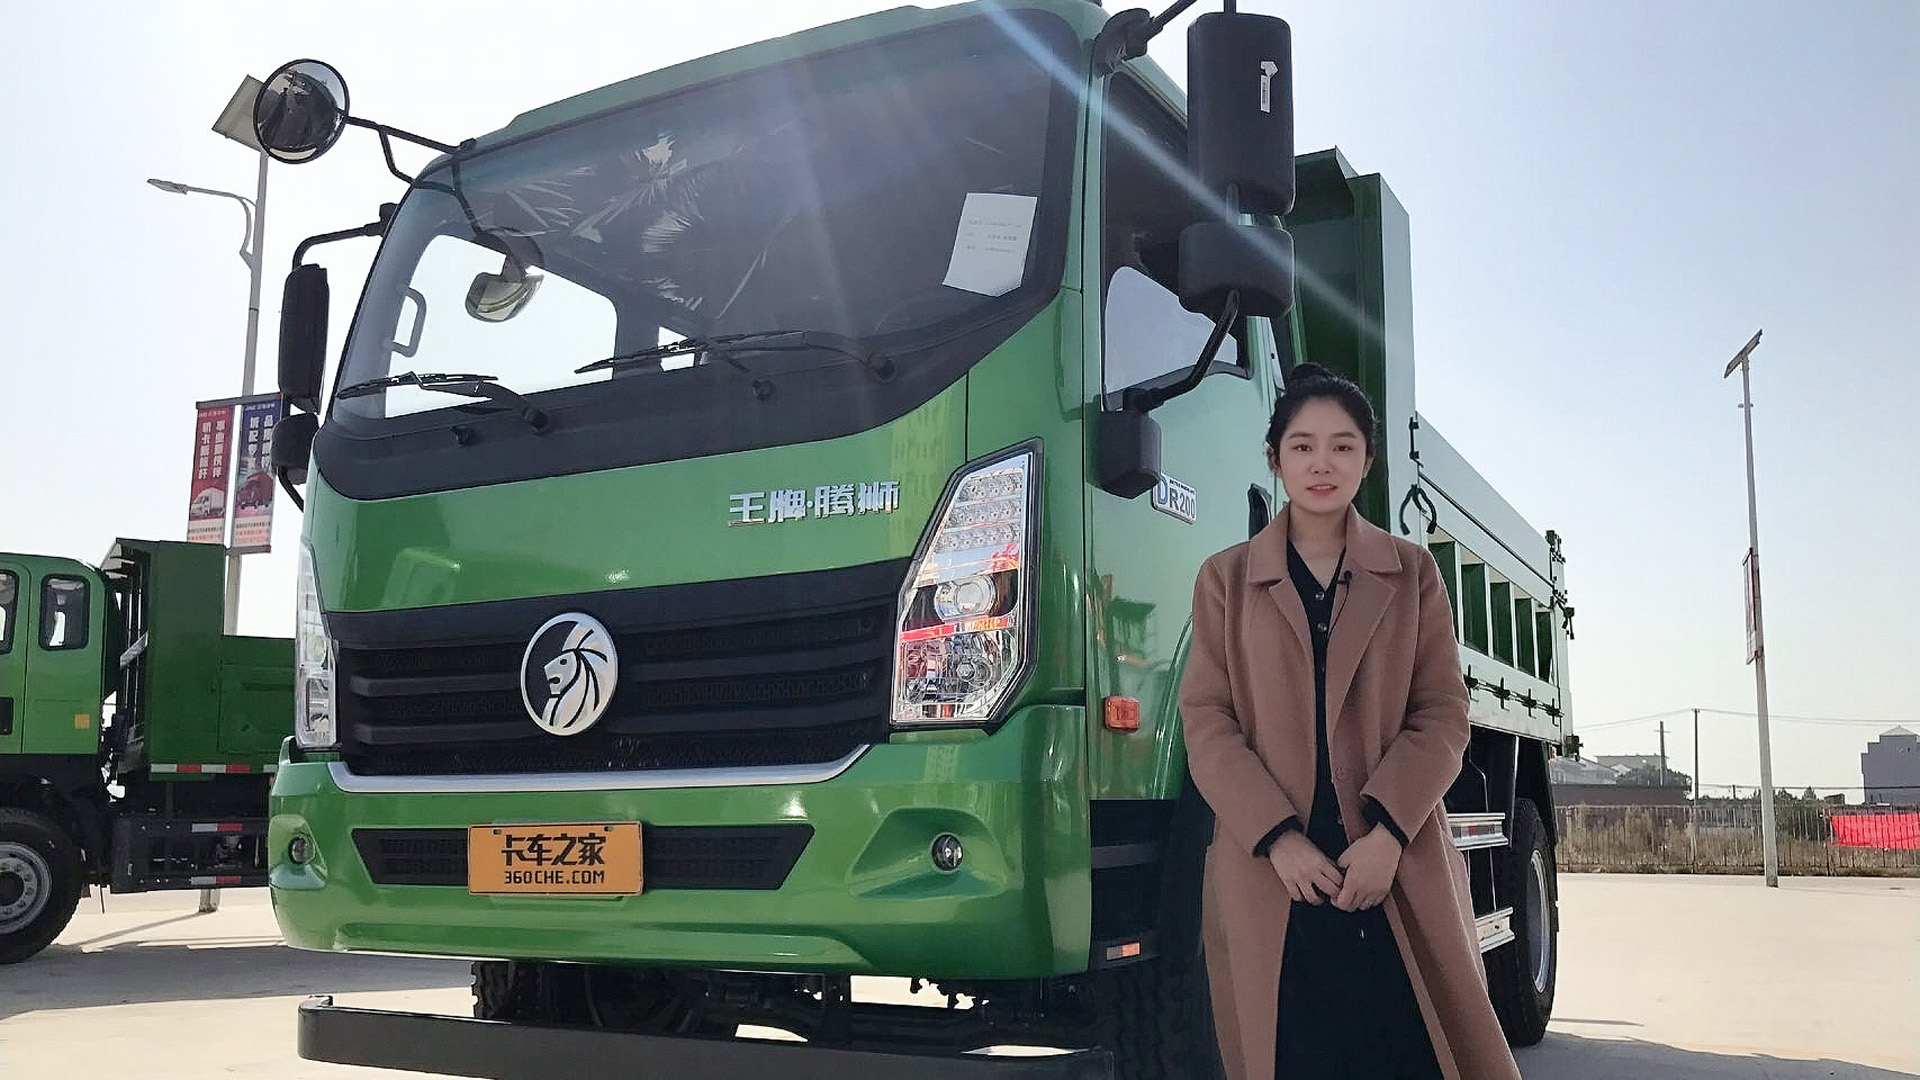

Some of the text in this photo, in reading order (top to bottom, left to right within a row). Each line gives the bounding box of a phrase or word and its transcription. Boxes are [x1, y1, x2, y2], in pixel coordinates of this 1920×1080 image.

[728, 480, 900, 526] 王牌·腾狮
[502, 832, 607, 867] 卡车之家
[504, 870, 605, 885] 360CHE.COM
